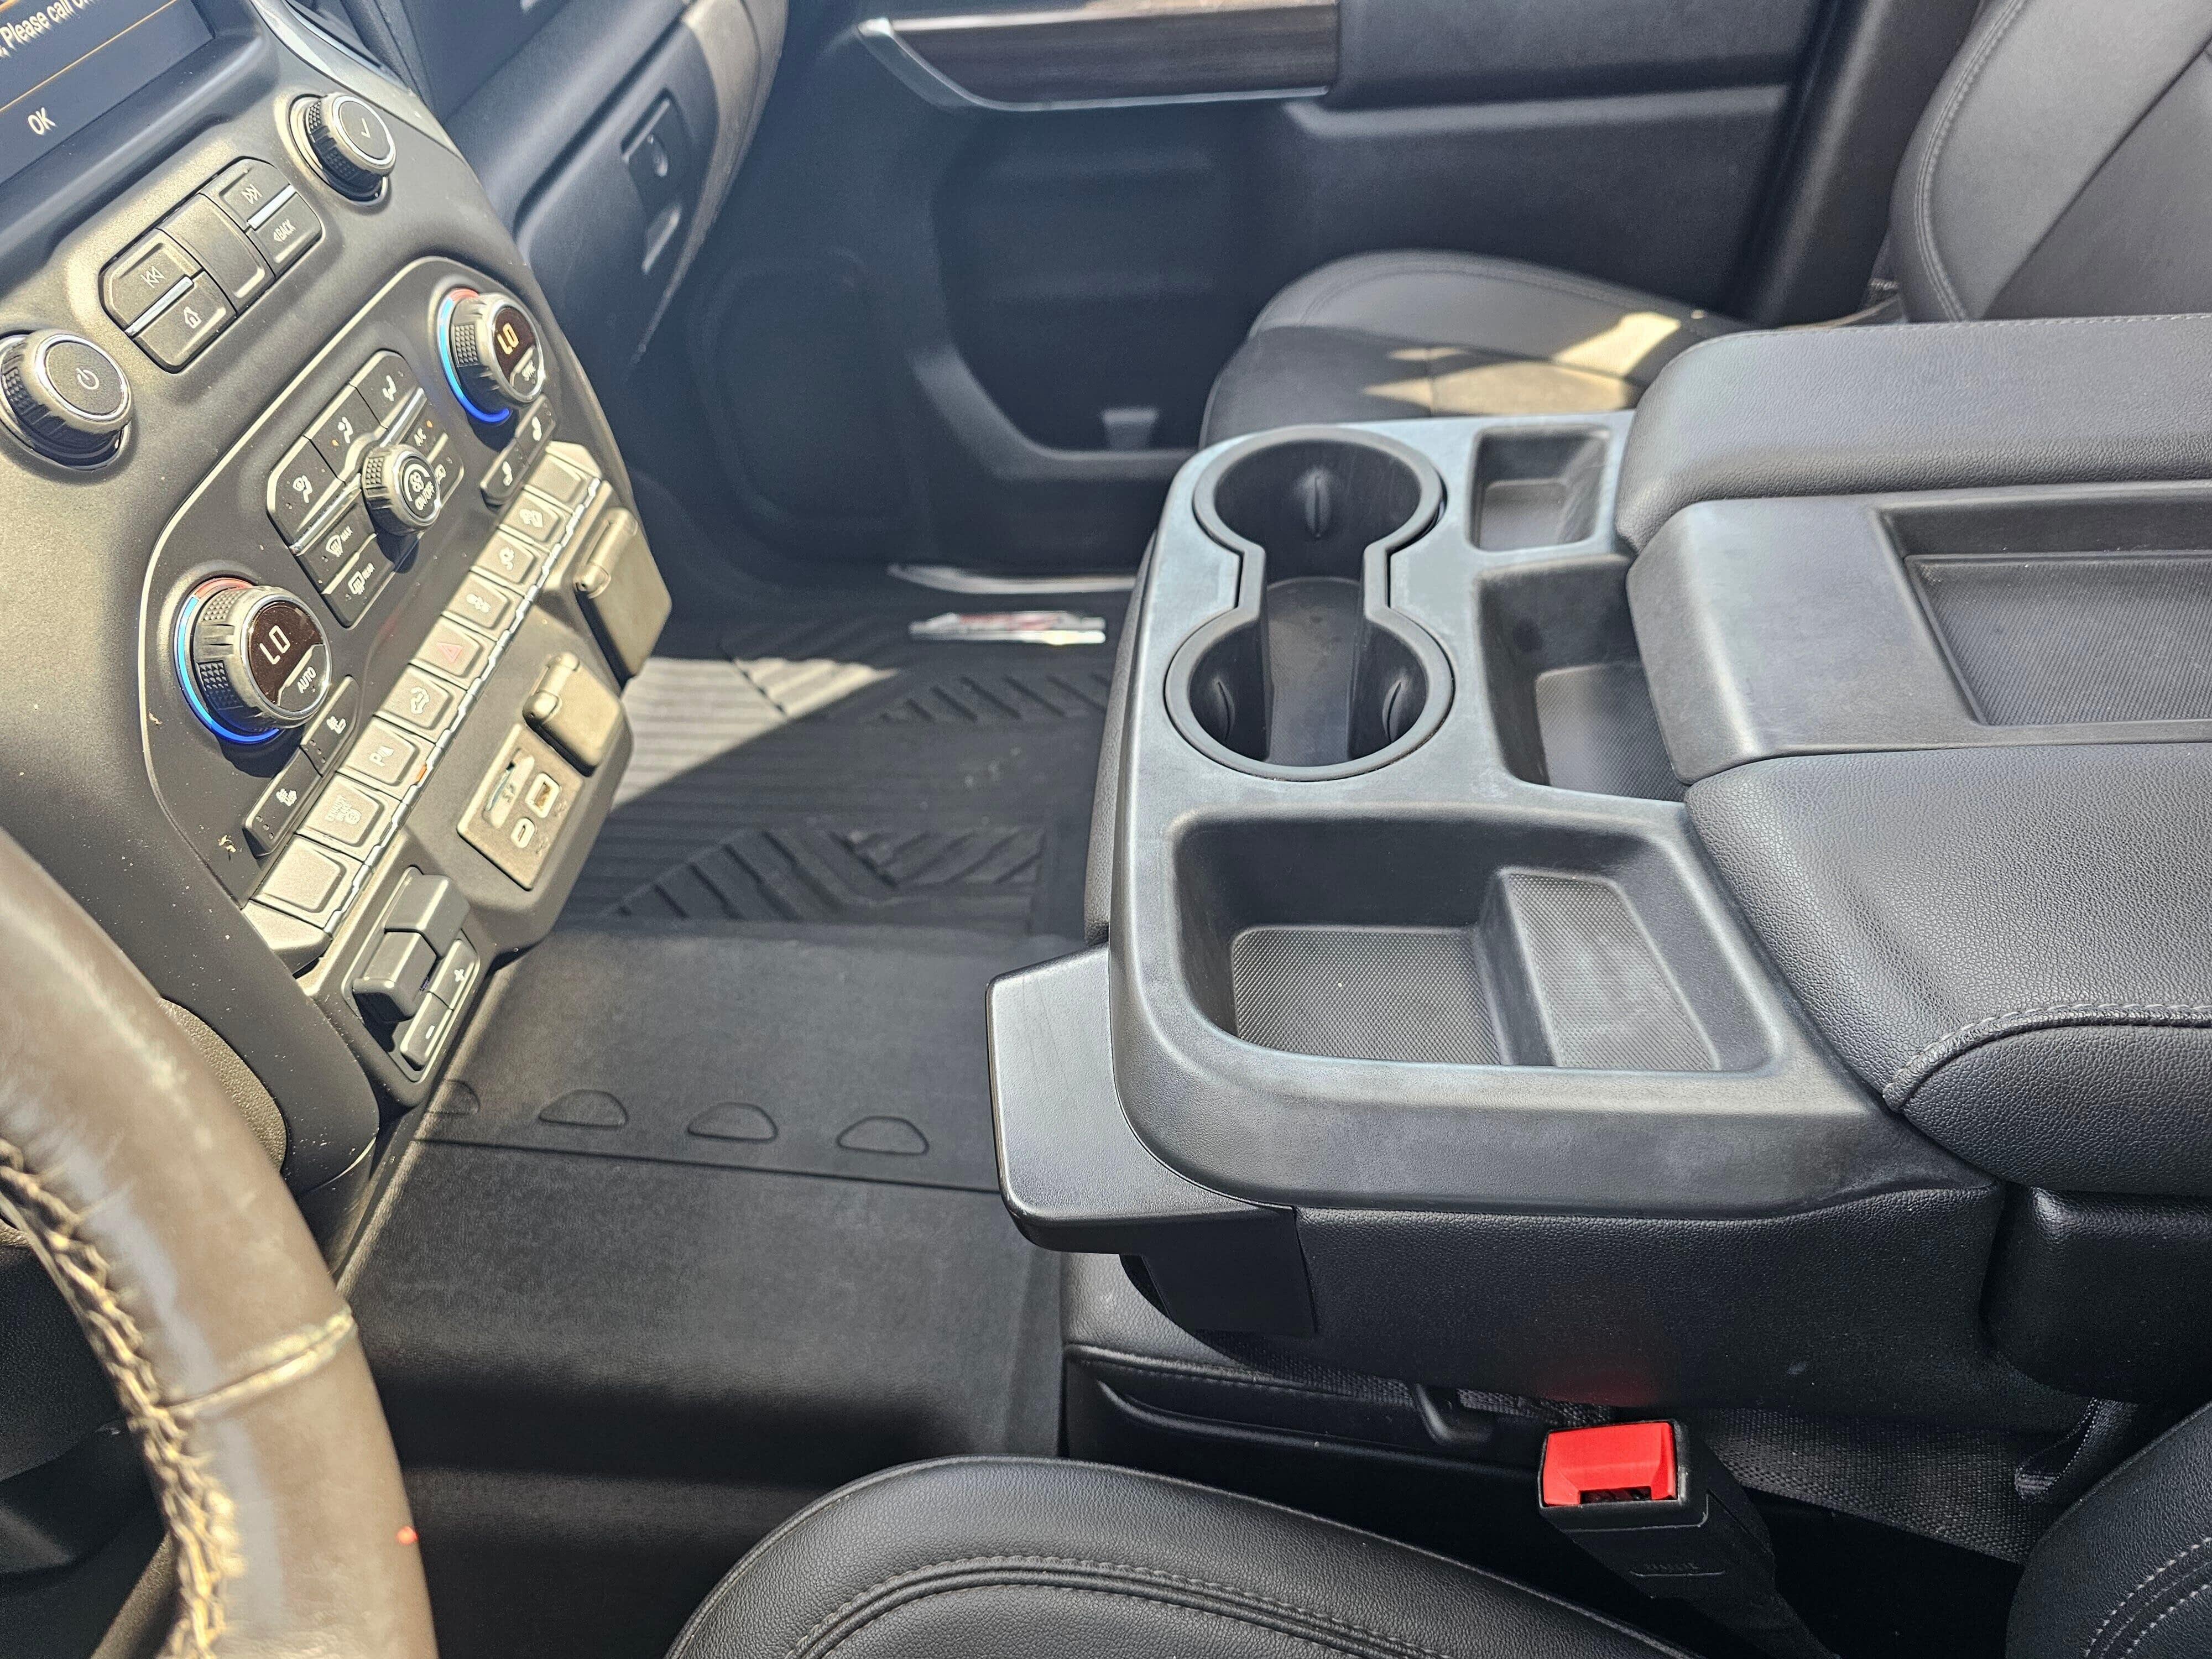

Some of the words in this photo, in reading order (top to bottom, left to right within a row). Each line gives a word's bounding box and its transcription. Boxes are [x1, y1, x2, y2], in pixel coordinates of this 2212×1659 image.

[0, 12, 51, 51] Please
[47, 0, 76, 23] call
[28, 107, 56, 134] OK
[275, 219, 296, 241] BACK
[414, 428, 426, 446] A/C
[415, 481, 434, 510] ON/OFF
[340, 525, 353, 541] MAX
[259, 625, 290, 664] LO
[297, 666, 316, 693] AUTO
